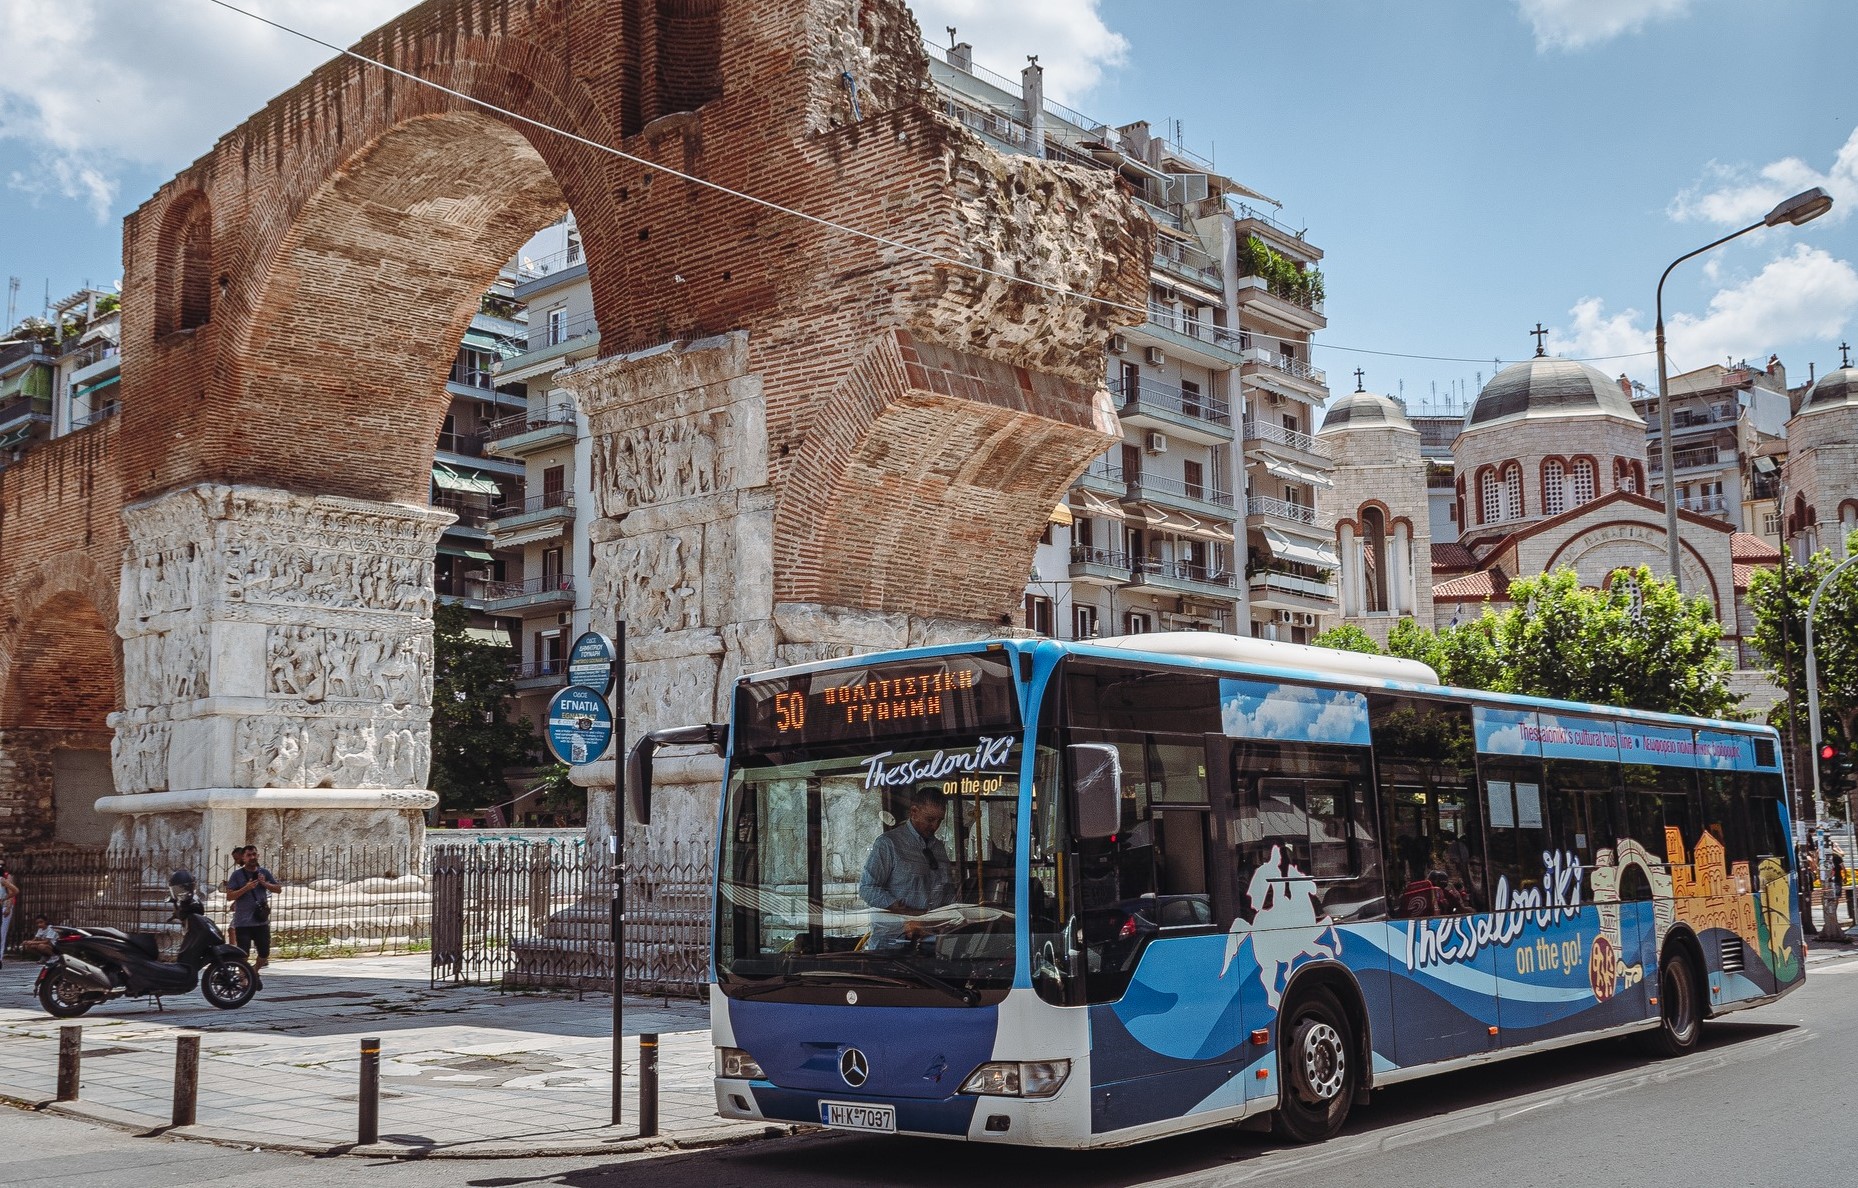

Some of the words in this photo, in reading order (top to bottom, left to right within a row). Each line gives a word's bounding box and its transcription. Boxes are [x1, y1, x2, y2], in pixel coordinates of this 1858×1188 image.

[824, 670, 973, 705] ΠΟΛΙΤΙΣΤΙΚΗ
[560, 699, 599, 712] ΕΓΝΑΤΙΑ
[776, 691, 806, 734] 50
[847, 695, 941, 724] ΓΡΑΜΜΗ
[1574, 729, 1602, 747] cultural
[1603, 731, 1617, 748] bus
[942, 780, 957, 795] on
[960, 777, 979, 794] the
[1516, 946, 1534, 975] on
[1536, 936, 1559, 972] the
[1562, 932, 1583, 975] go!
